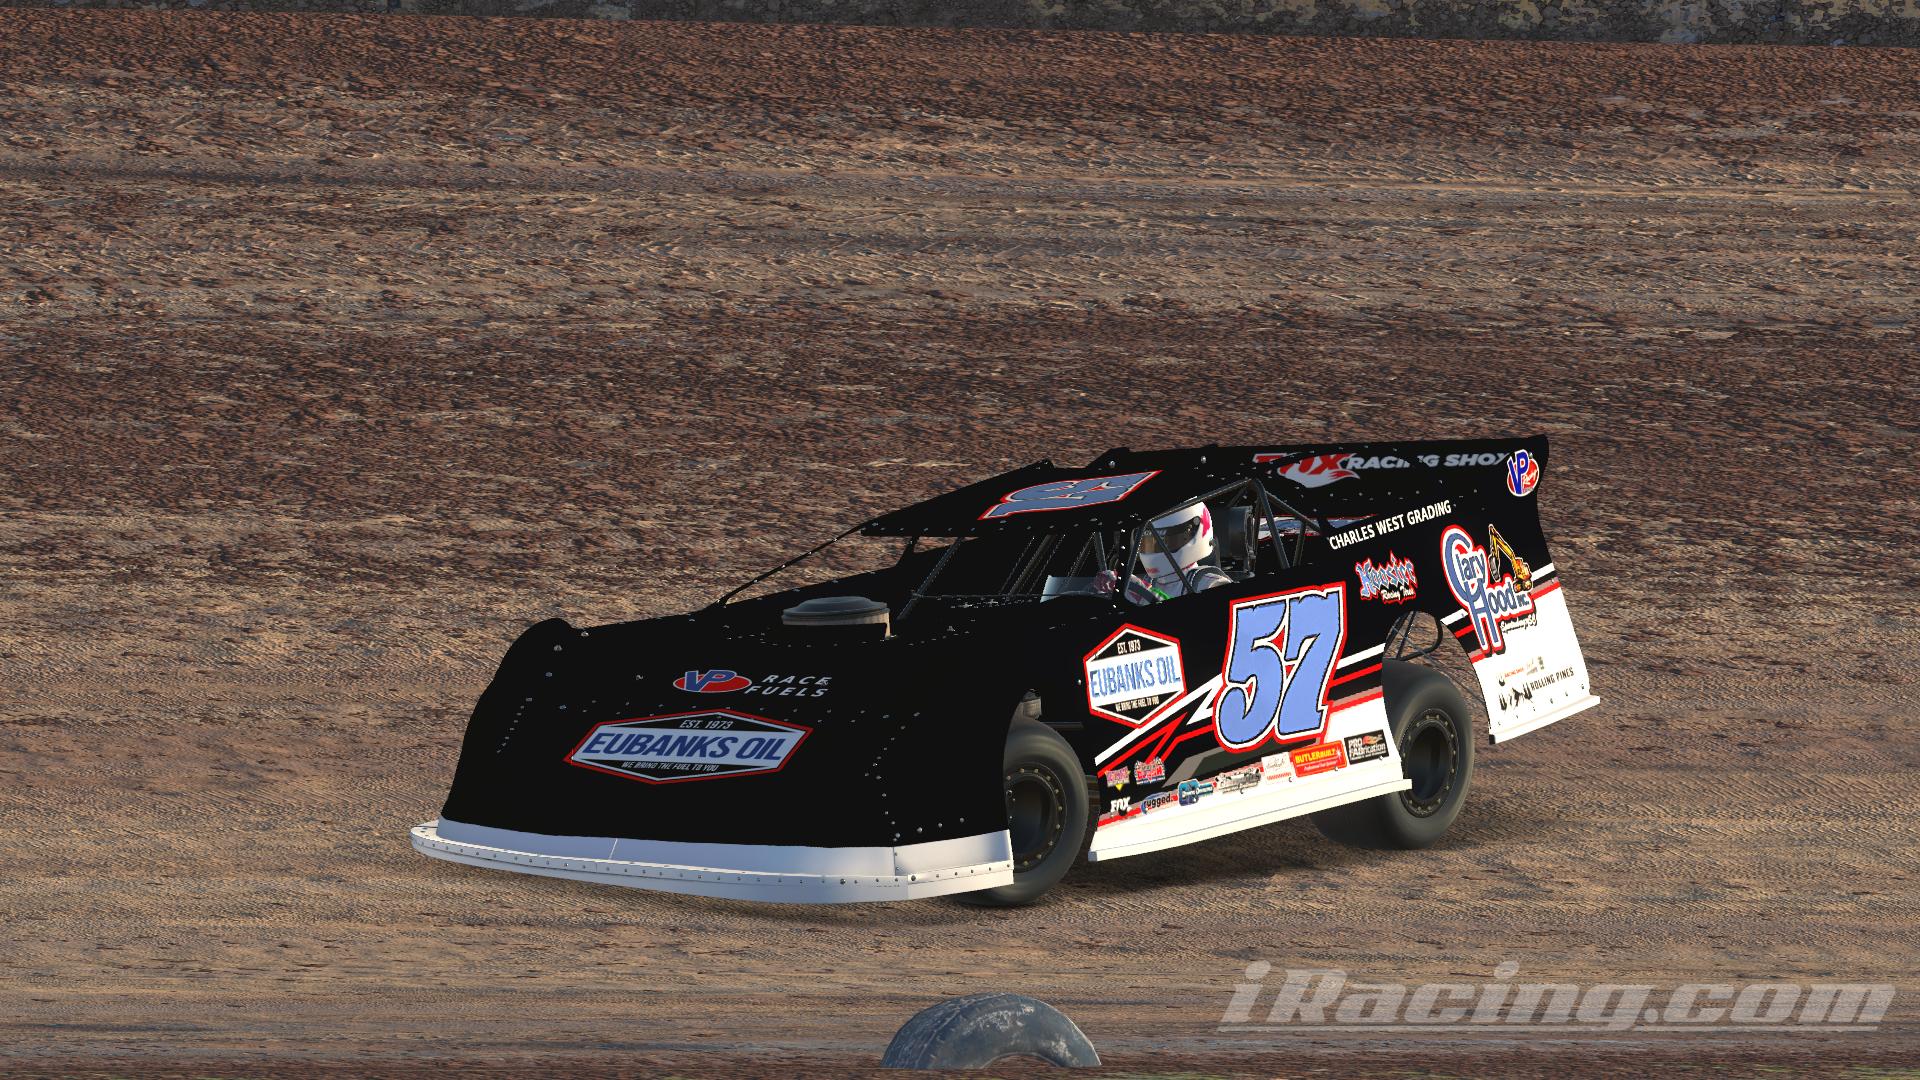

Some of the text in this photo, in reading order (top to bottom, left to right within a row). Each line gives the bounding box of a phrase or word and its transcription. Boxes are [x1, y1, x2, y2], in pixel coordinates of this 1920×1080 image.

[1507, 449, 1530, 495] VP
[1328, 499, 1452, 550] CHARLES WEST GRADING
[1089, 655, 1181, 698] EUBANKS OIL
[1216, 585, 1344, 749] 57
[1529, 674, 1556, 691] ROLLING
[1555, 666, 1575, 682] PINES
[684, 669, 738, 693] VP
[744, 685, 828, 698] FUELS
[762, 674, 832, 686] RACE
[679, 719, 734, 730] EST. 1973
[582, 732, 787, 760] EUBANKS OIL
[1348, 736, 1362, 749] PRO
